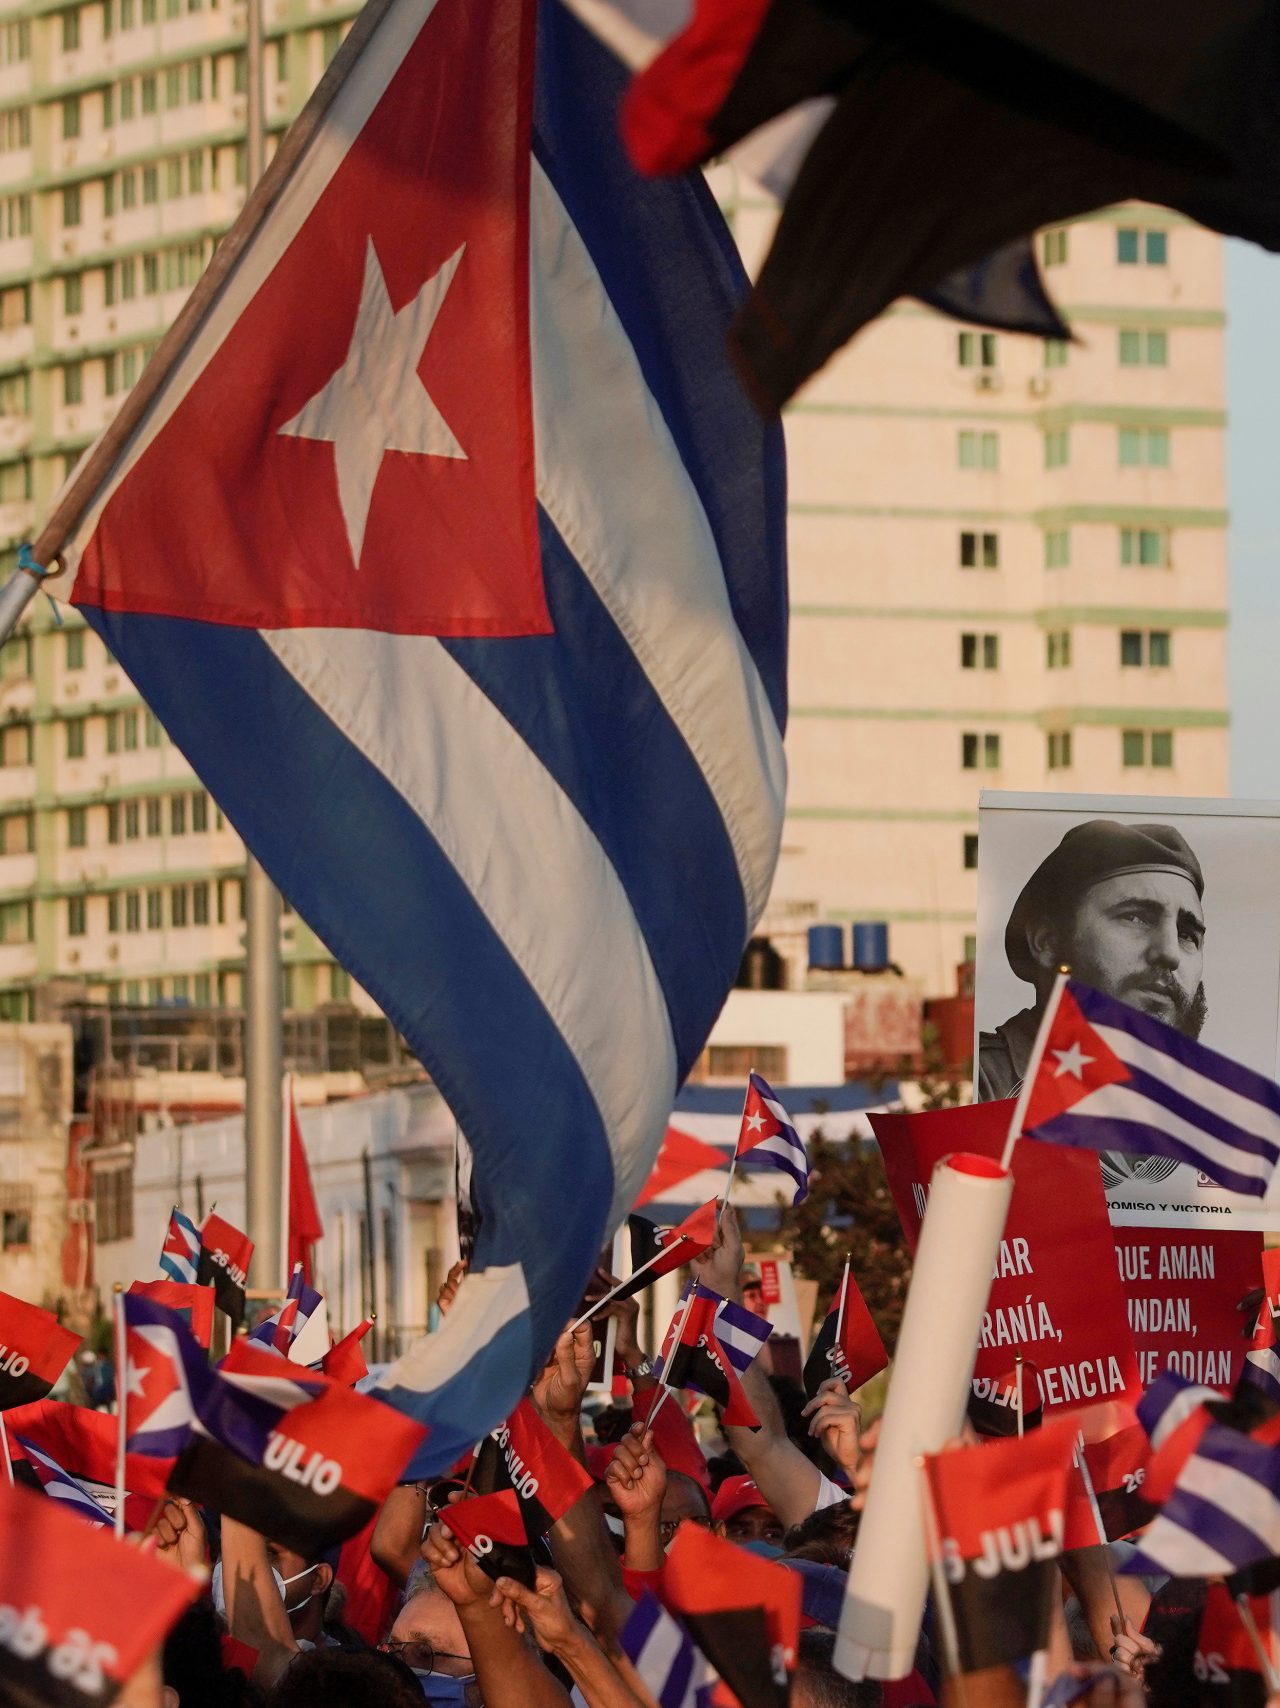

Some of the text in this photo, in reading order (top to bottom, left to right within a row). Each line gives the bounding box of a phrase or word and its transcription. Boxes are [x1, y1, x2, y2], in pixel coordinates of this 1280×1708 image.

[1159, 1203, 1168, 1212] Y
[1171, 1204, 1232, 1214] VICTORIA
[210, 1247, 230, 1268] 26
[1159, 1245, 1216, 1280] AMAN
[504, 1446, 539, 1500] JULIO
